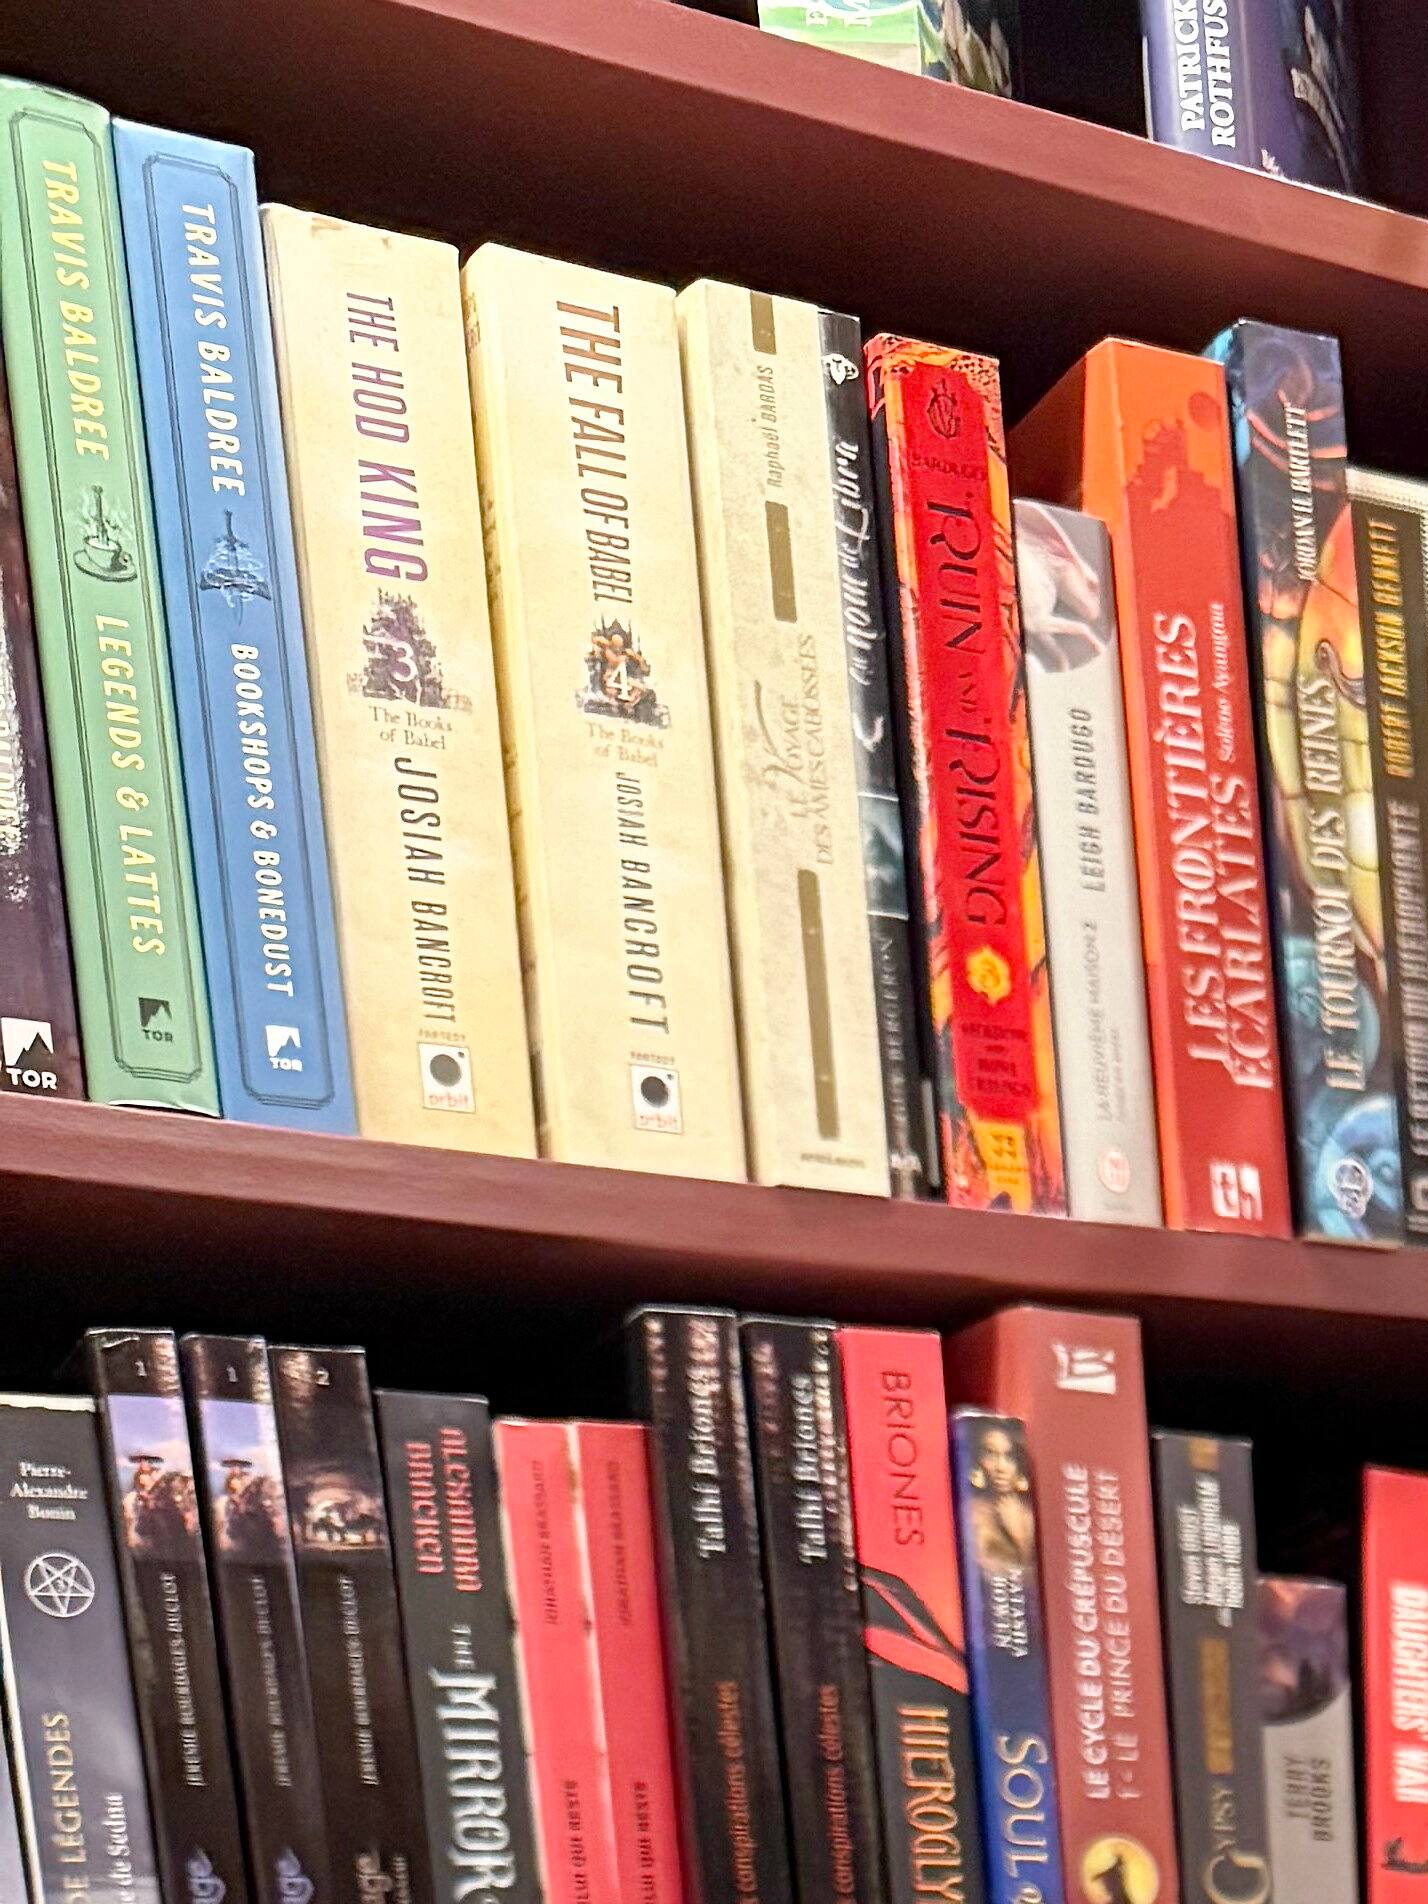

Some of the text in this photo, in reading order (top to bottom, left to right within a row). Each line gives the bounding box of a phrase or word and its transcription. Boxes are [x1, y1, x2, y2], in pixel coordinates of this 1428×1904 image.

[1173, 0, 1205, 131] PATRICK
[42, 159, 110, 462] TRAVIS BALDREE
[181, 202, 247, 498] TRAVIS BALDREE
[346, 292, 429, 583] THE HOD KING
[556, 300, 634, 605] THE FALL OF BABEL
[926, 488, 983, 654] RUIN
[369, 705, 454, 734] The Books
[379, 727, 447, 750] of Babel
[1374, 612, 1409, 699] JACKSON
[95, 613, 166, 957] LEGENDS & LATTES
[230, 642, 295, 998] BOOKSHOPS & BONEDUST
[945, 714, 1008, 928] RISING
[1068, 706, 1107, 895] LEIGH BARDUGO
[1379, 703, 1416, 779] ROBERT
[393, 756, 457, 1024] JOSIAH BANCROFT
[614, 771, 670, 1035] JOSIAH BANCROFT
[1152, 611, 1230, 1063] LES FRONTIÈRES
[1297, 674, 1367, 1093] LE TOURNOI DES REINES
[5, 1066, 58, 1091] TOR
[142, 1028, 174, 1044] TOR
[268, 1055, 304, 1073] TOR
[428, 1090, 470, 1109] orbit
[405, 1441, 446, 1575] BRACKEN
[440, 1426, 483, 1593] ALEXANDRA
[877, 1369, 927, 1548] BRIONES
[1093, 1471, 1127, 1567] DÉSERT
[1062, 1463, 1111, 1800] LE CYCLE DU CRÉPUSCULE
[1101, 1574, 1129, 1614] DU
[1101, 1614, 1136, 1718] PRINCE
[42, 1710, 83, 1860] LÉGENDES
[428, 1665, 517, 1902] MIRROR
[996, 1735, 1049, 1878] SOUL
[1308, 1756, 1336, 1843] BROOKS
